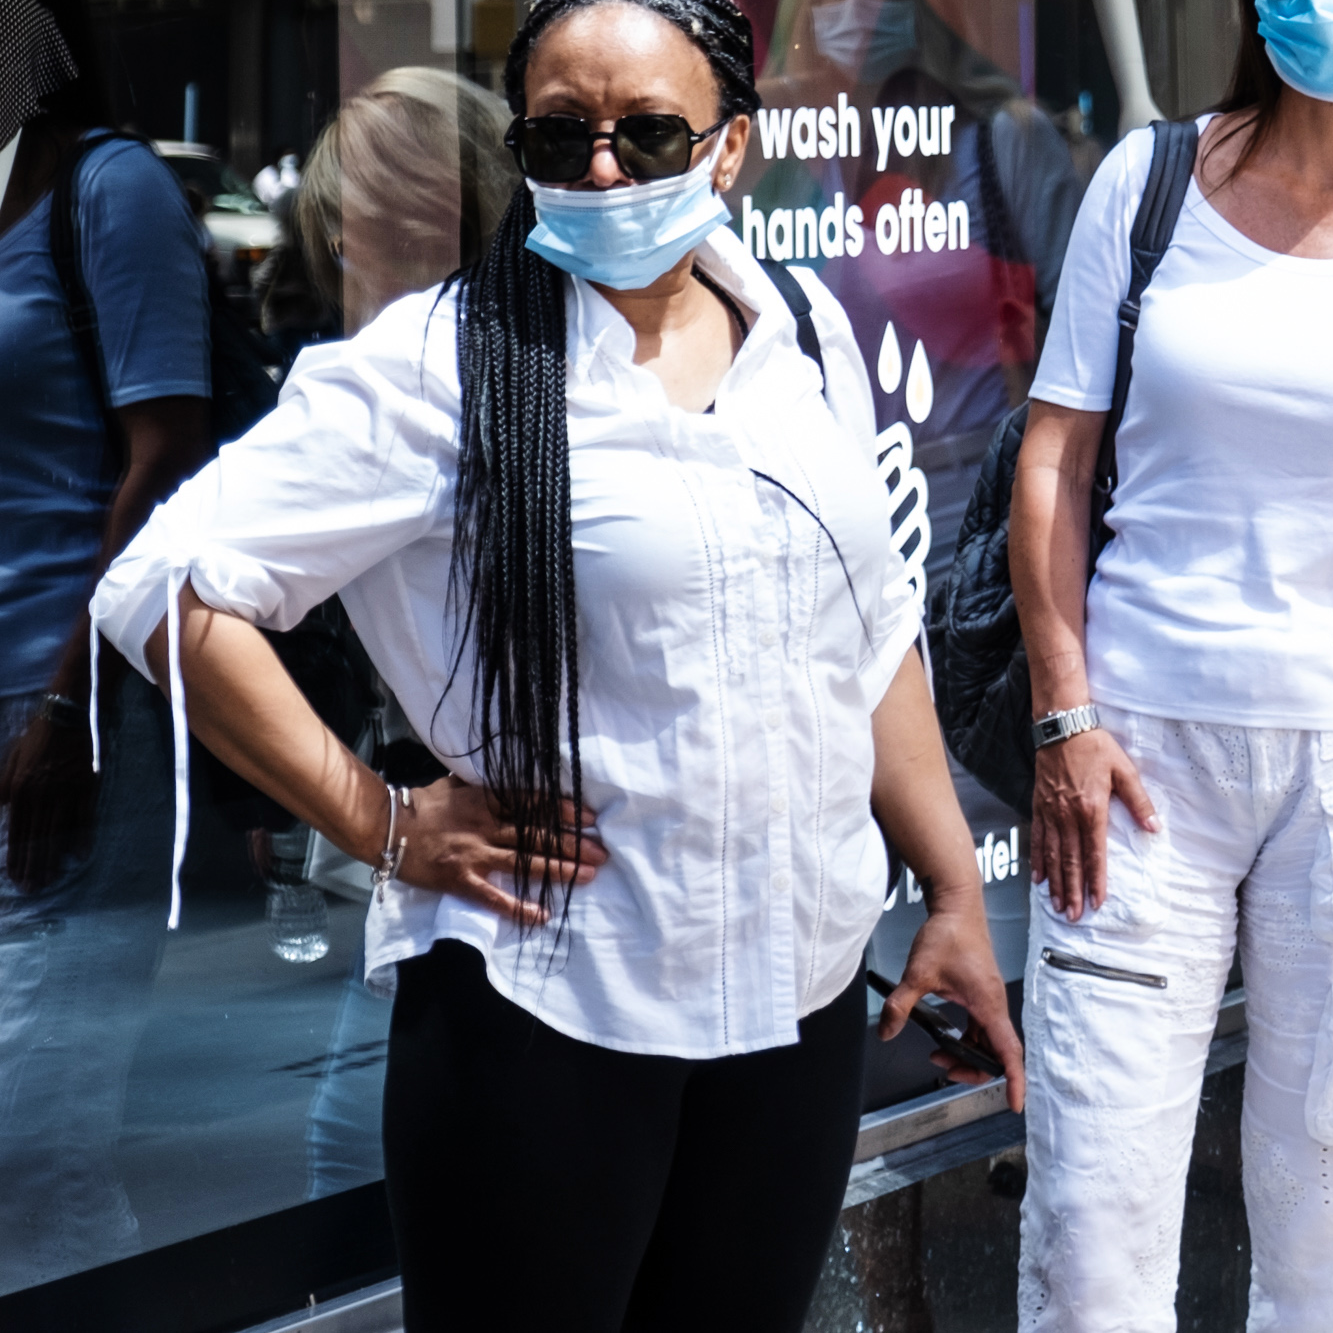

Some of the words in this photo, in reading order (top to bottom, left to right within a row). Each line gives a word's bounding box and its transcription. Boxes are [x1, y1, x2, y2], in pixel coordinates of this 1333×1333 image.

[757, 92, 861, 160] wash
[871, 104, 956, 172] your
[742, 191, 865, 262] hands
[875, 187, 970, 257] often
